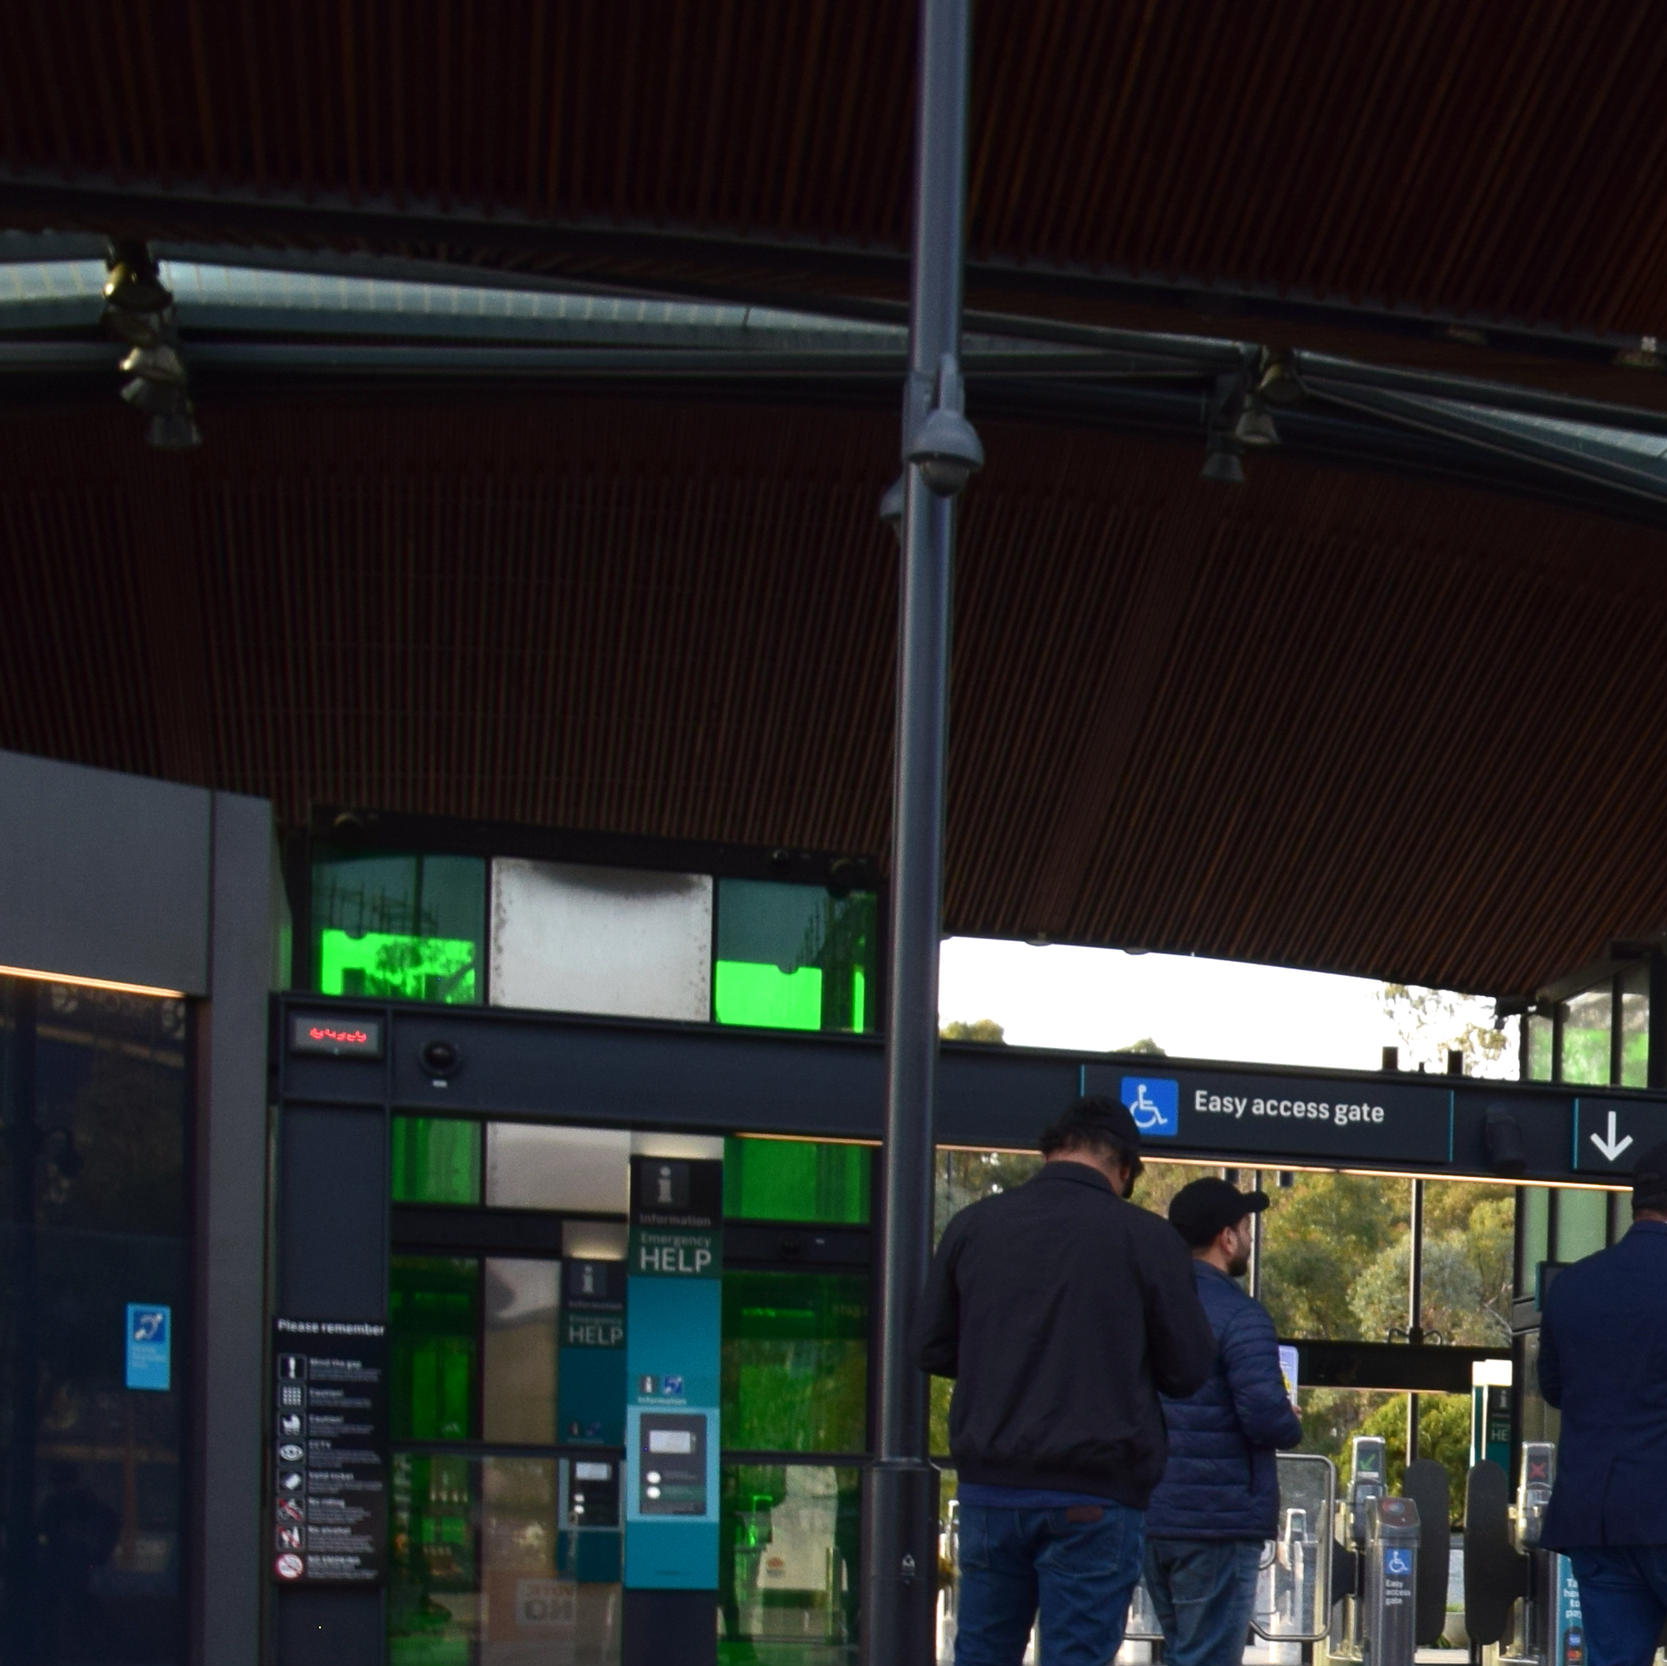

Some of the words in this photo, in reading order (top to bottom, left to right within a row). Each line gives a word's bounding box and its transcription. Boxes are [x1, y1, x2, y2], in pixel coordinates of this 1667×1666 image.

[1194, 1089, 1247, 1118] Easy
[1252, 1098, 1329, 1119] access
[1333, 1102, 1384, 1125] gate
[639, 1213, 711, 1227] Information
[640, 1231, 712, 1248] Emergency
[639, 1247, 712, 1273] HELP
[278, 1318, 319, 1334] Please
[321, 1321, 385, 1336] remember
[568, 1326, 624, 1345] HELP
[1385, 1579, 1403, 1589] Easy
